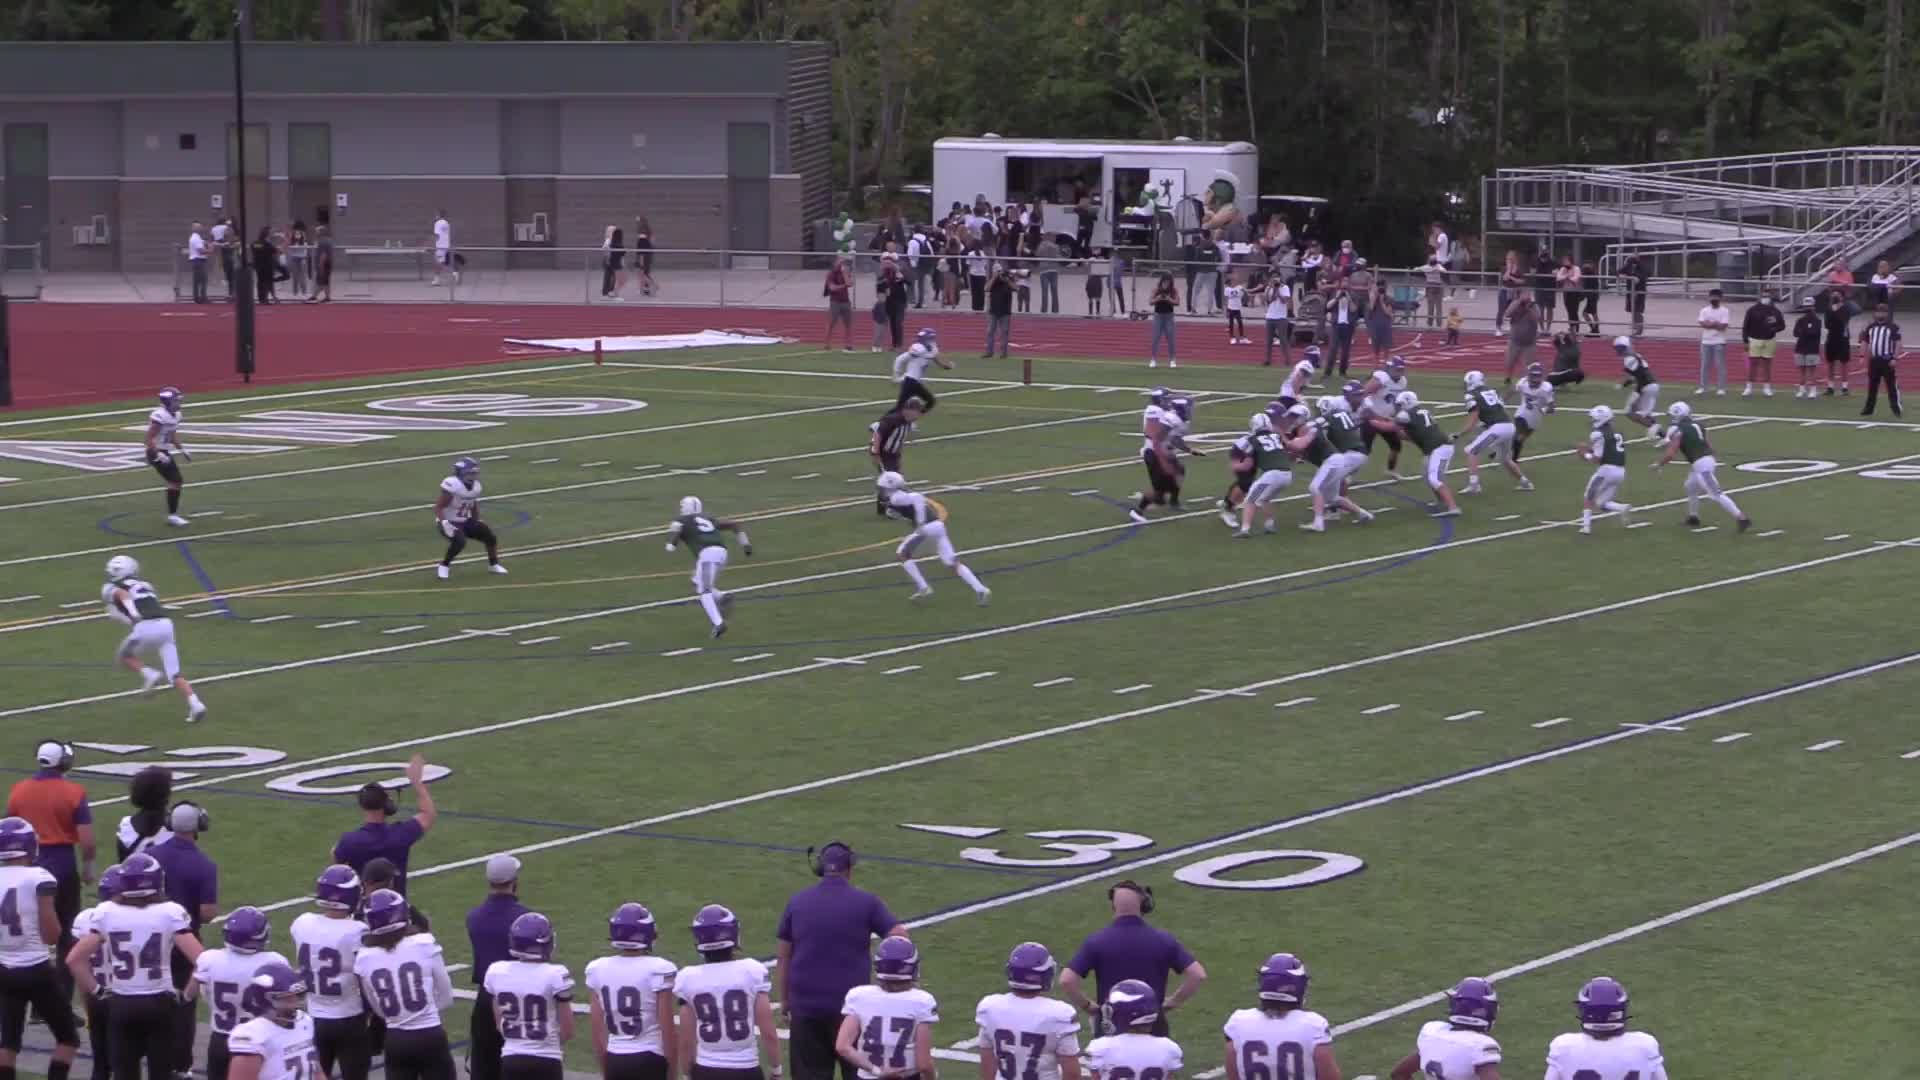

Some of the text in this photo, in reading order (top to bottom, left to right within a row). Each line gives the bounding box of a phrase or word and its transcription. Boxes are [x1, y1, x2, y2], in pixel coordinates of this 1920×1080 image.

[1614, 433, 1625, 451] 2
[108, 930, 163, 980] 54
[298, 942, 342, 996] 42
[370, 961, 418, 1018] 80
[601, 985, 643, 1036] 19
[497, 991, 549, 1041] 20
[692, 988, 750, 1043] 98
[863, 1015, 915, 1068] 47
[993, 1028, 1047, 1080] 67
[1241, 1040, 1304, 1080] 60
